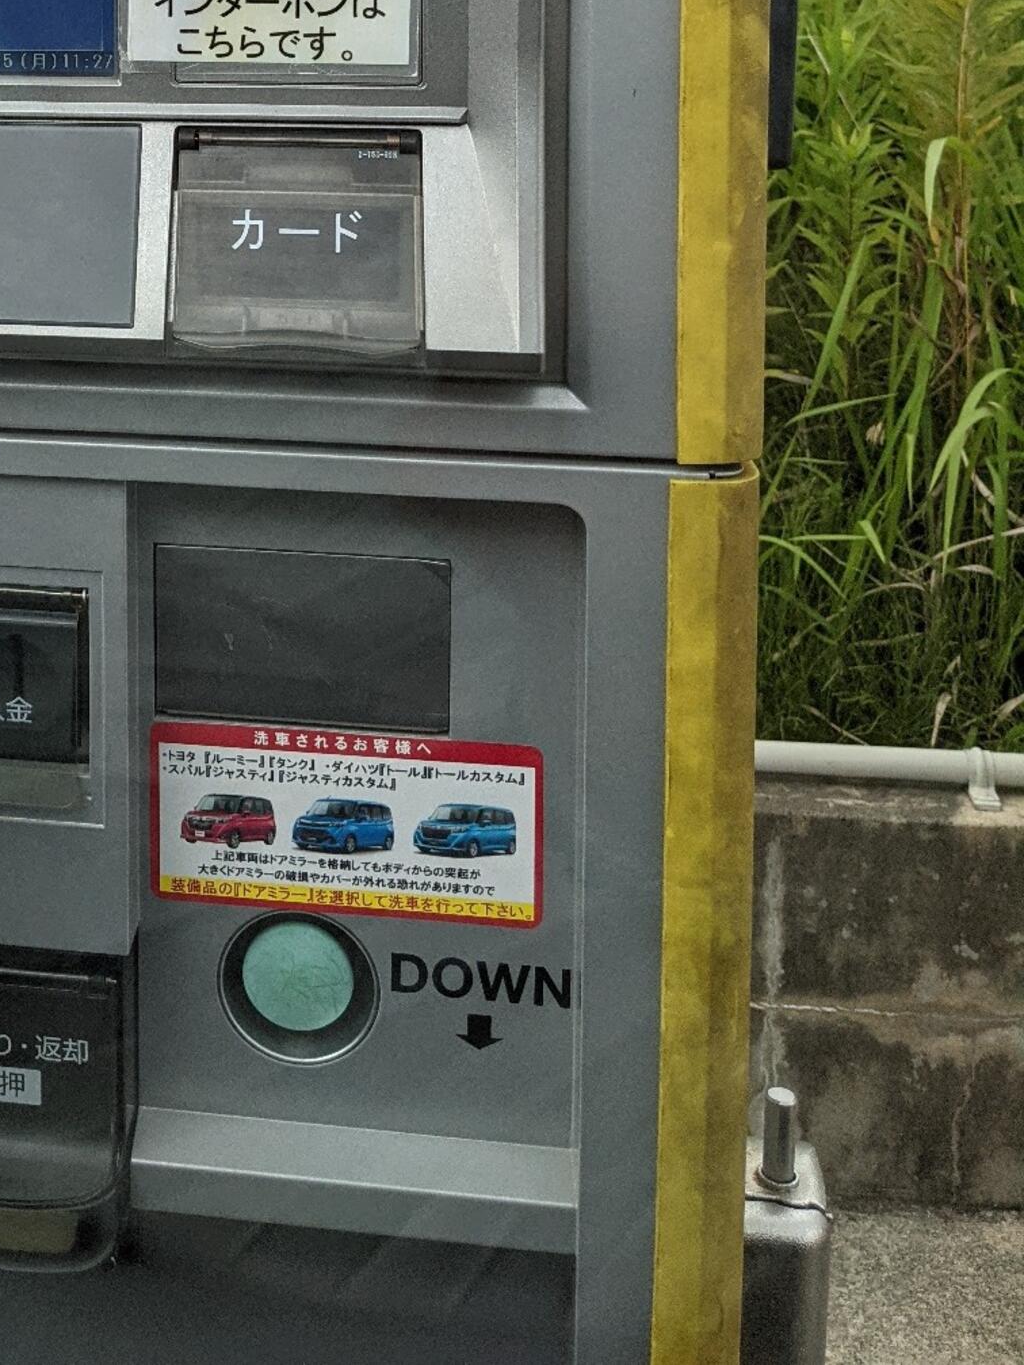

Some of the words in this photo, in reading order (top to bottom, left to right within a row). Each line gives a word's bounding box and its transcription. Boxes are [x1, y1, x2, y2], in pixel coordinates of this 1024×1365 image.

[177, 25, 353, 61] こちらです。
[231, 209, 363, 254] カード
[254, 730, 431, 755] 洗車されるお客様へ
[198, 863, 496, 896] 大きくドアミラーの破損やカバーが外れる恐れがありますので
[211, 850, 481, 880] 上記車両はドアミラーを格納してもボディからの突起が
[170, 877, 532, 920] 装備品の『ドアミラー』を選択して洗車を行って下さい。
[391, 952, 571, 1009] DOWN
[0, 1070, 27, 1098] 押
